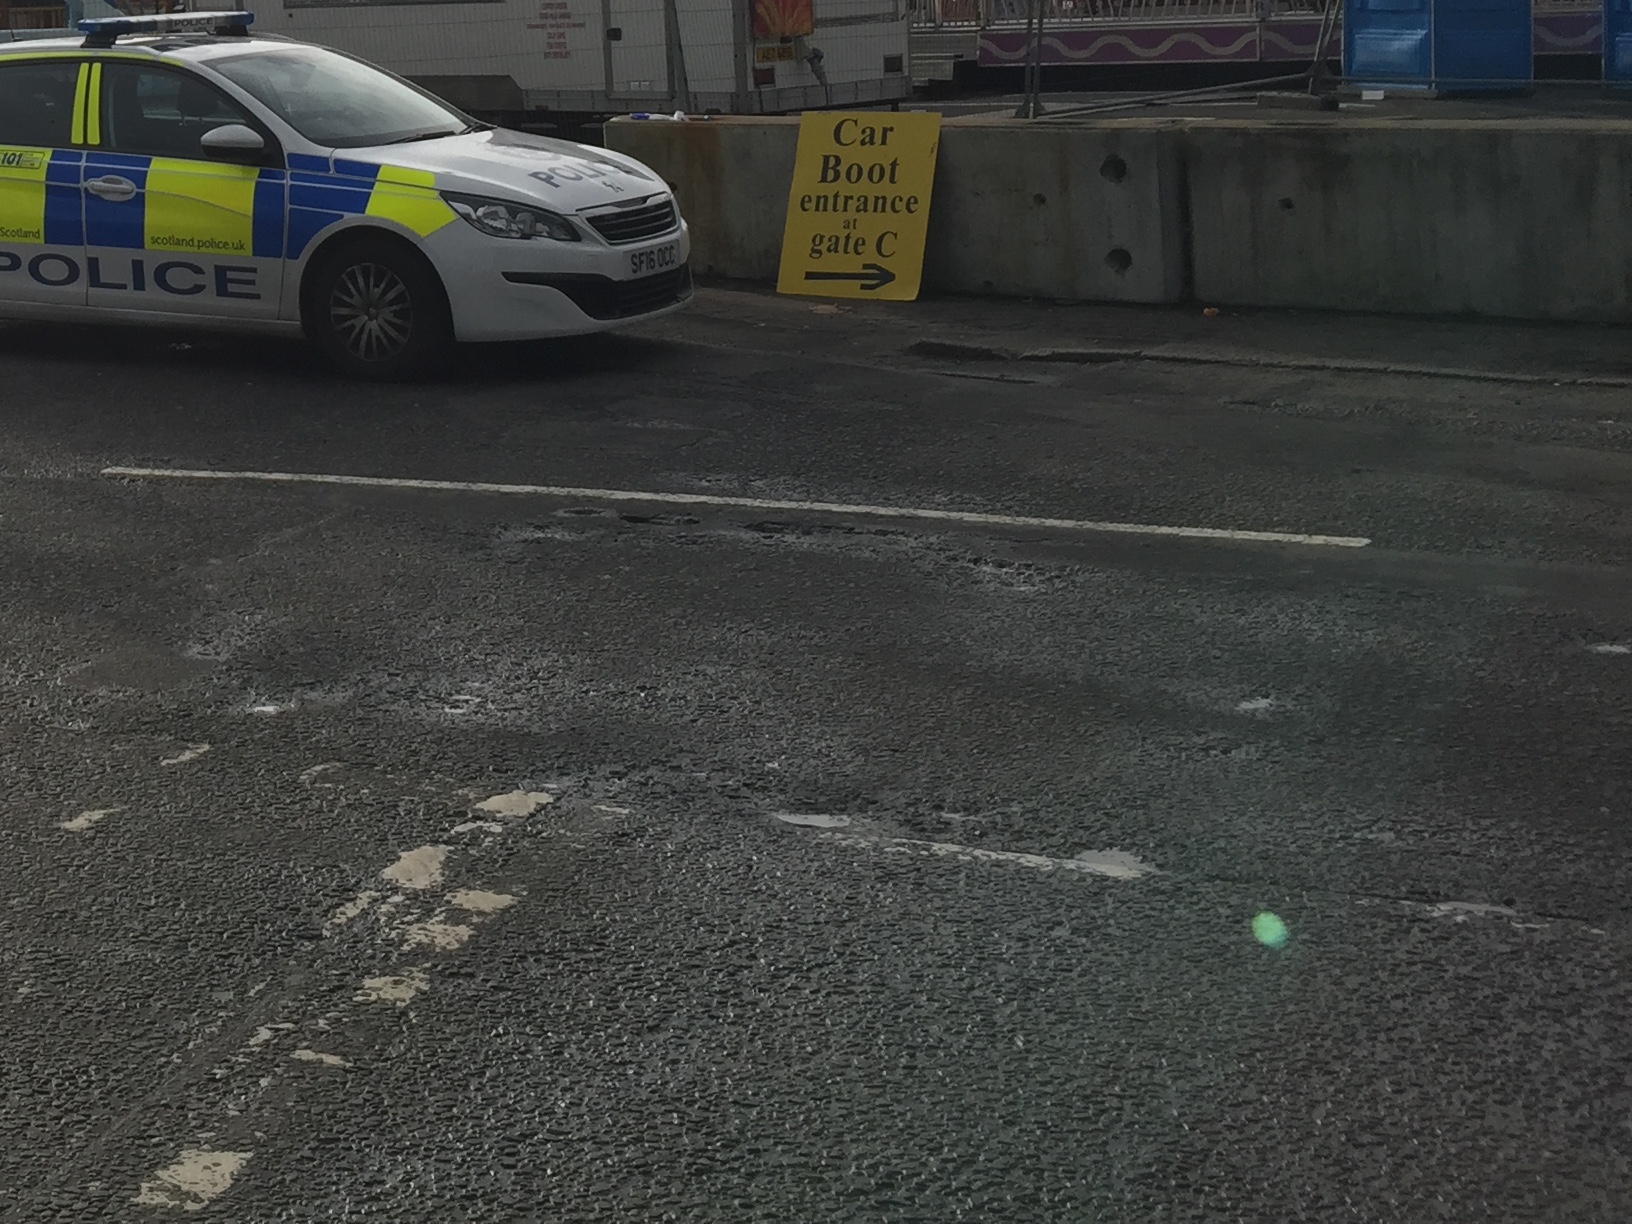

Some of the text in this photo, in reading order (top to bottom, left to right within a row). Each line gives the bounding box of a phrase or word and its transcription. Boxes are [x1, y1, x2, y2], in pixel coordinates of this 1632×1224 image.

[174, 17, 214, 28] POLICE
[833, 117, 895, 147] Car
[1, 152, 23, 166] 101
[817, 154, 900, 185] Boot
[799, 189, 919, 215] entrance
[842, 217, 858, 230] at
[150, 235, 246, 252] scotland.police.uk
[808, 230, 898, 260] gate C
[630, 250, 656, 275] SF16
